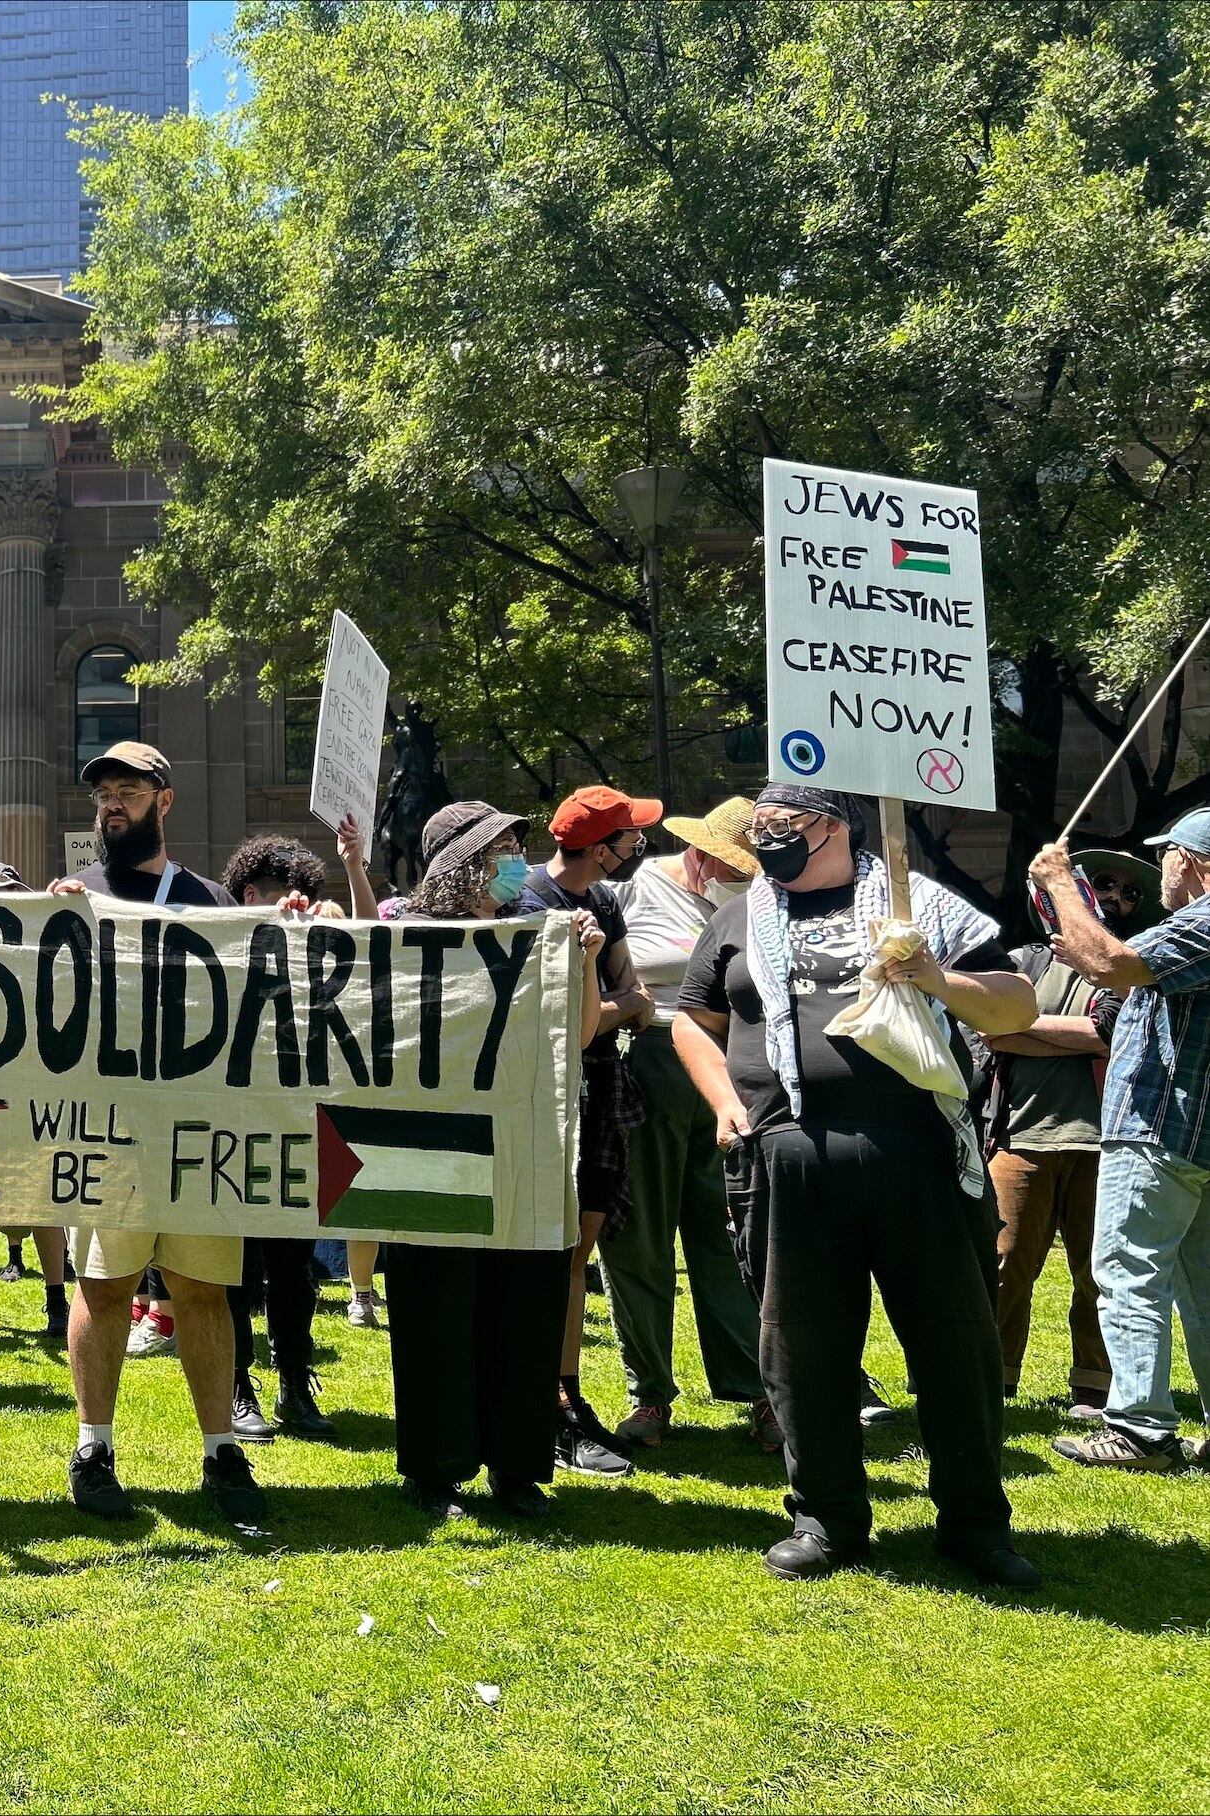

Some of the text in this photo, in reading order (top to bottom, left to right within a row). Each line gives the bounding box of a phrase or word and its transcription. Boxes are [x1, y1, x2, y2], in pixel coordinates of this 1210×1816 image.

[784, 475, 979, 534] JEWS FOR
[780, 536, 868, 569] FREE
[808, 574, 974, 629] PALESTINE
[340, 627, 361, 663] NOT
[373, 667, 385, 696] MY
[782, 639, 972, 683] CEASEFIRE
[327, 688, 353, 733] FREE
[830, 690, 972, 748] NOW!
[319, 756, 343, 787] JEWS
[326, 728, 356, 769] END THE
[71, 840, 93, 849] OUR
[28, 1098, 135, 1146] WILL
[170, 1119, 313, 1209] FREE
[51, 1151, 108, 1205] BE
